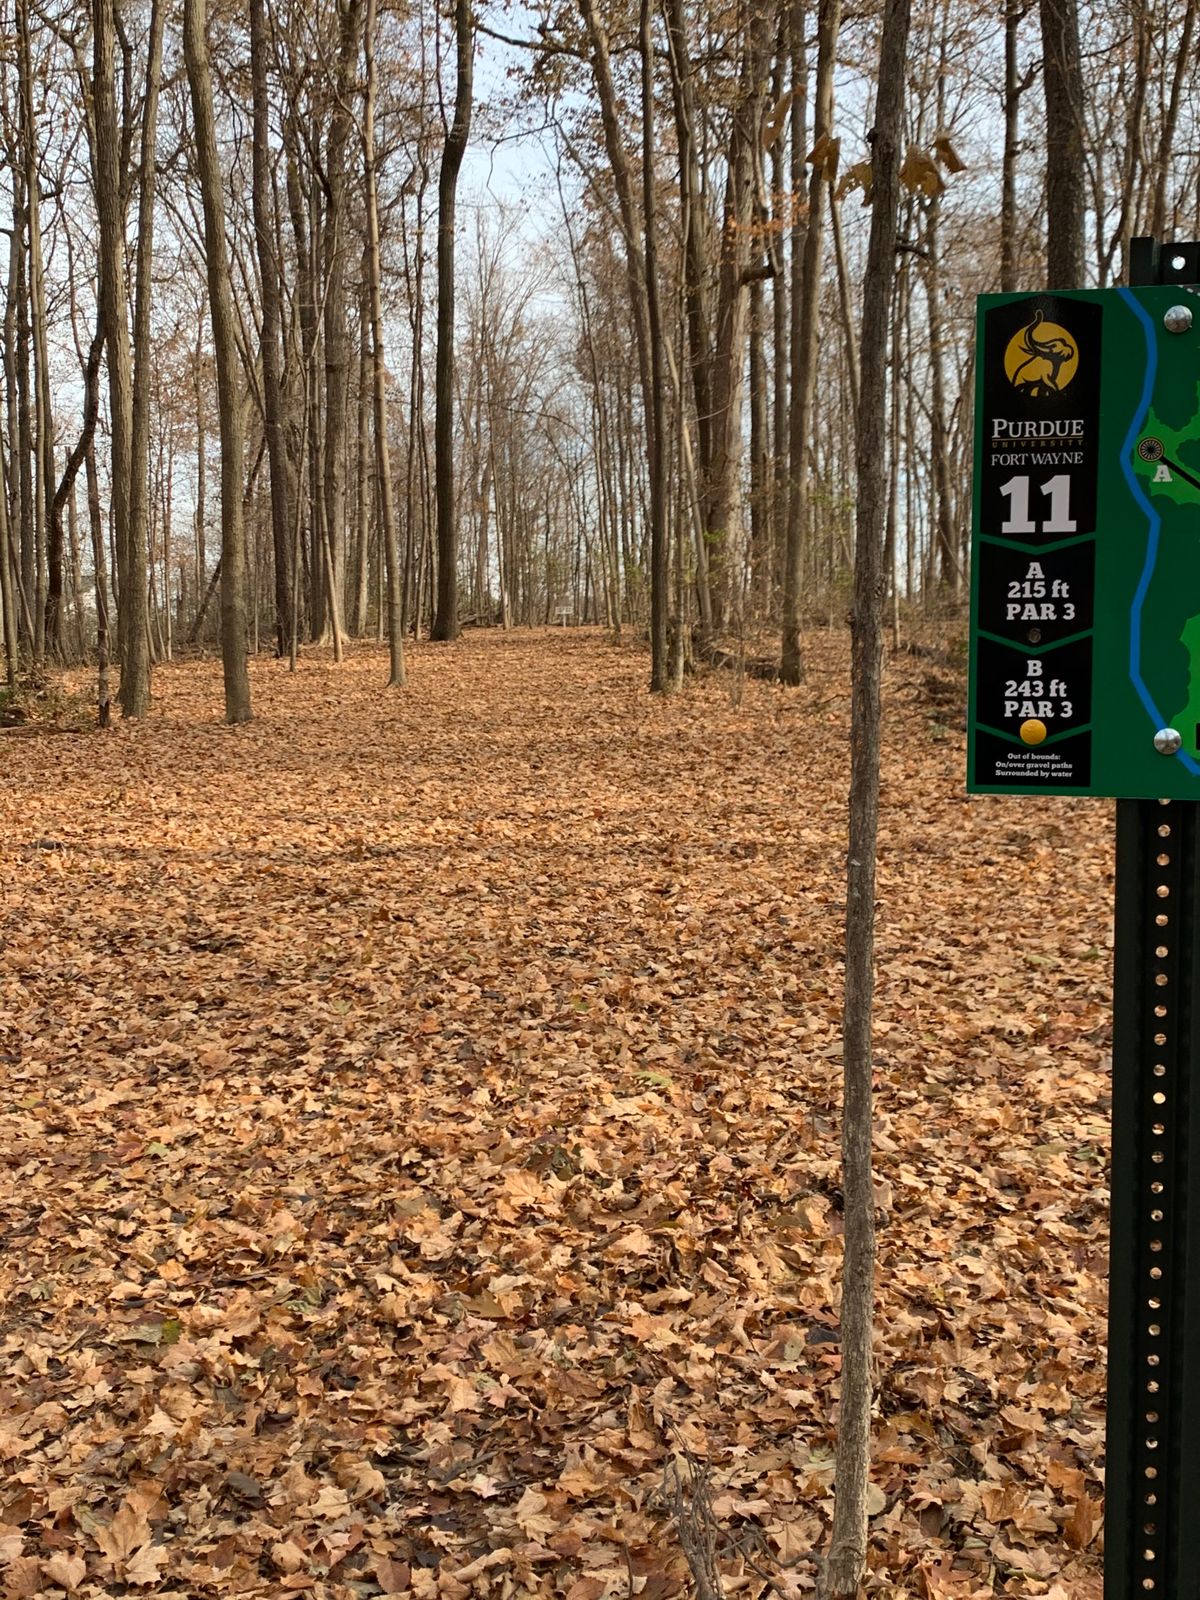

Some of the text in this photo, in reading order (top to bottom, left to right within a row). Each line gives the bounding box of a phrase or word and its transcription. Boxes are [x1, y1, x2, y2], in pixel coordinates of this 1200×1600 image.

[991, 418, 1084, 439] PURDUE
[992, 440, 1085, 448] UNIVERSITY
[991, 451, 1083, 466] FORT WAYNE
[1152, 465, 1173, 483] A
[999, 475, 1077, 534] 11
[1025, 562, 1045, 579] A
[1007, 579, 1069, 598] 215 ft
[1006, 603, 1076, 620] PAR 3
[1026, 660, 1043, 677] B
[1004, 679, 1067, 697] 243 ft
[1004, 701, 1073, 718] PAR 3
[1026, 761, 1050, 769] gravel
[1051, 761, 1073, 770] paths
[1040, 770, 1050, 778] by
